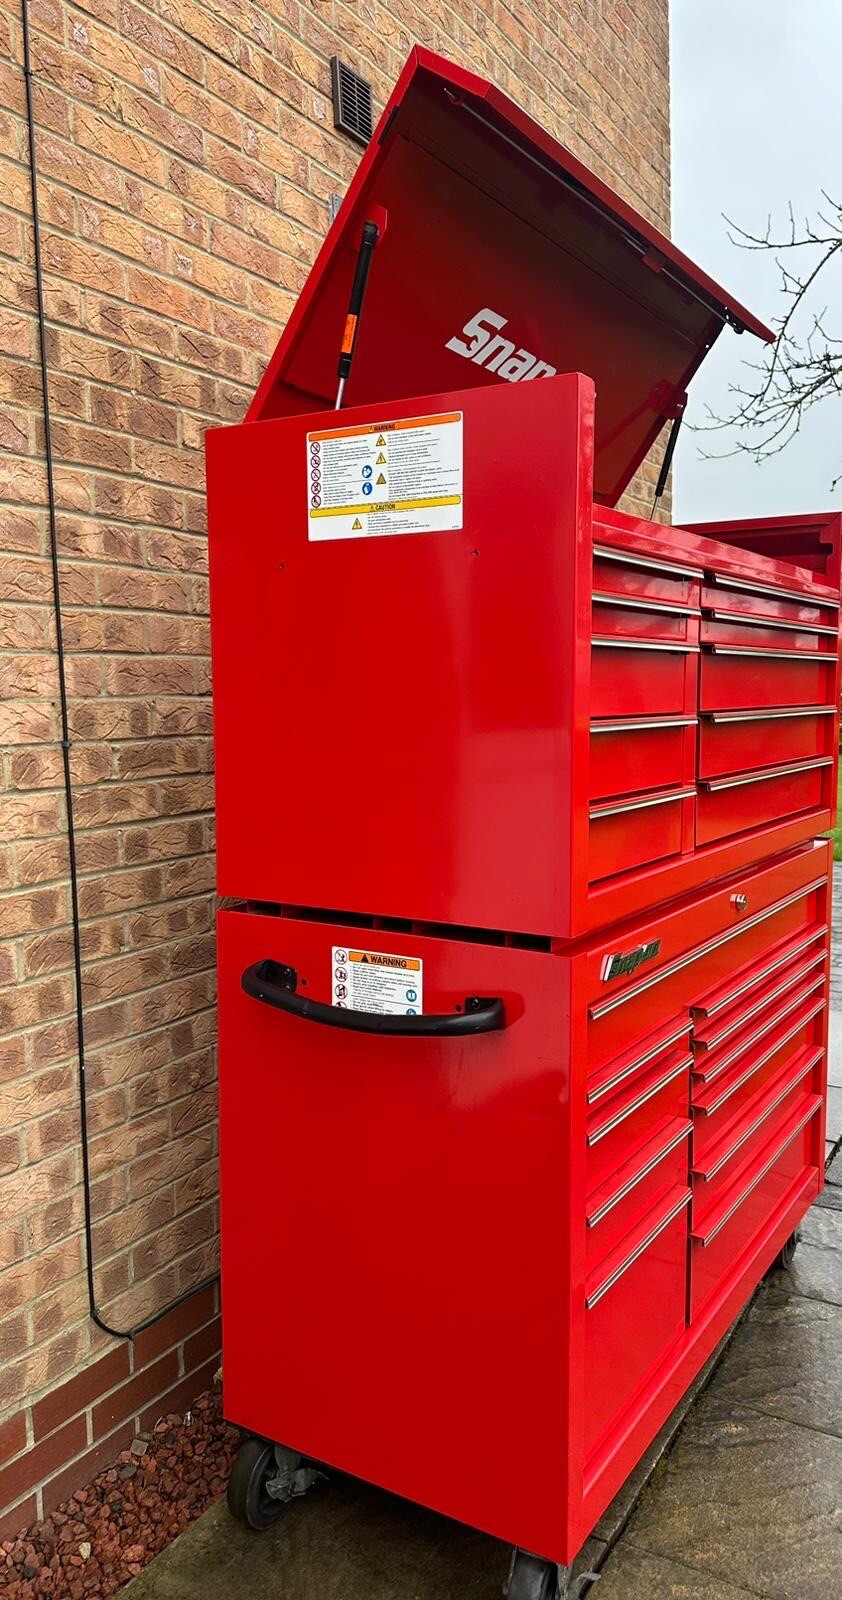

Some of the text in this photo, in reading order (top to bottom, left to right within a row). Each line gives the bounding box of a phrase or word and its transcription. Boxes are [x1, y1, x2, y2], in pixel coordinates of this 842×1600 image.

[374, 423, 396, 431] WARNING
[375, 503, 396, 511] CAUTION
[370, 955, 408, 968] WARNING
